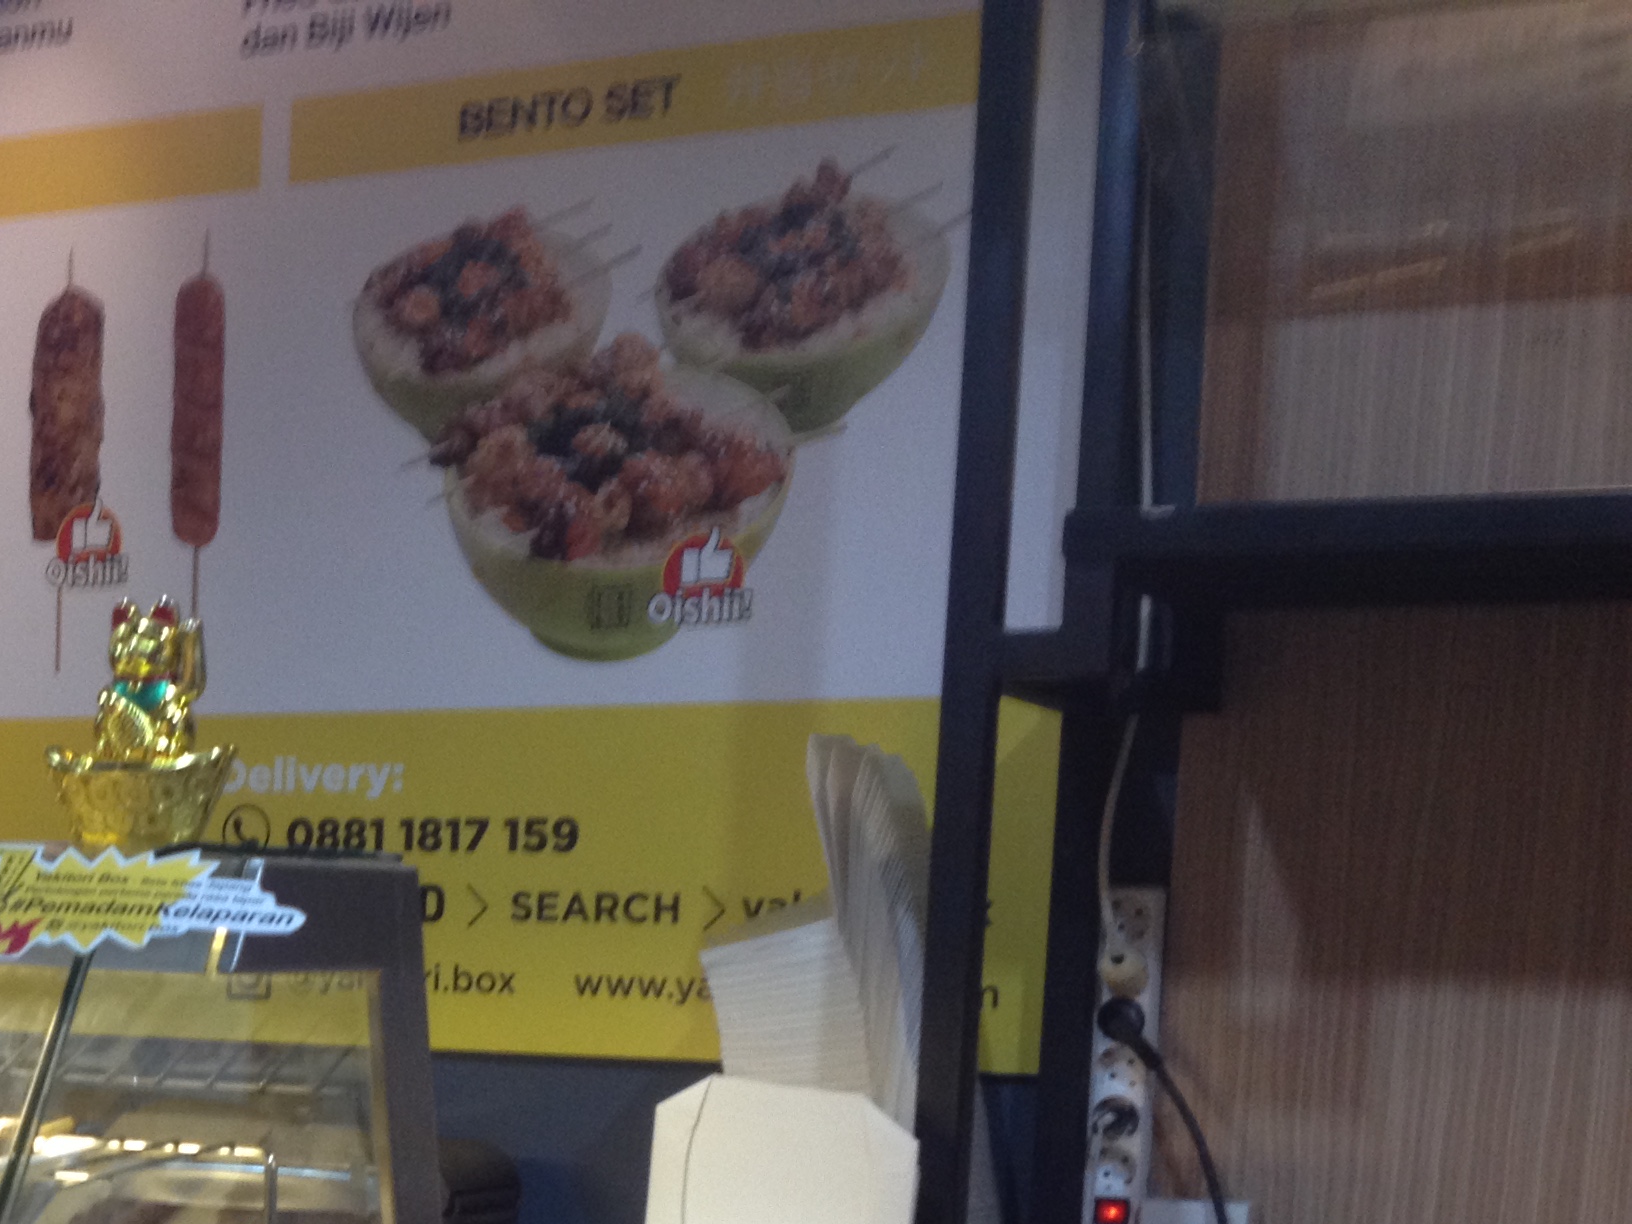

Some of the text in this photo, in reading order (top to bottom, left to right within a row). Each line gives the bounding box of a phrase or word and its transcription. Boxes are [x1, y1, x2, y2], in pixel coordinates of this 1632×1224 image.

[458, 85, 593, 142] BENTO
[604, 74, 682, 125] SET
[286, 815, 580, 853] 0881 1817 159
[510, 890, 681, 924] SEARCH
